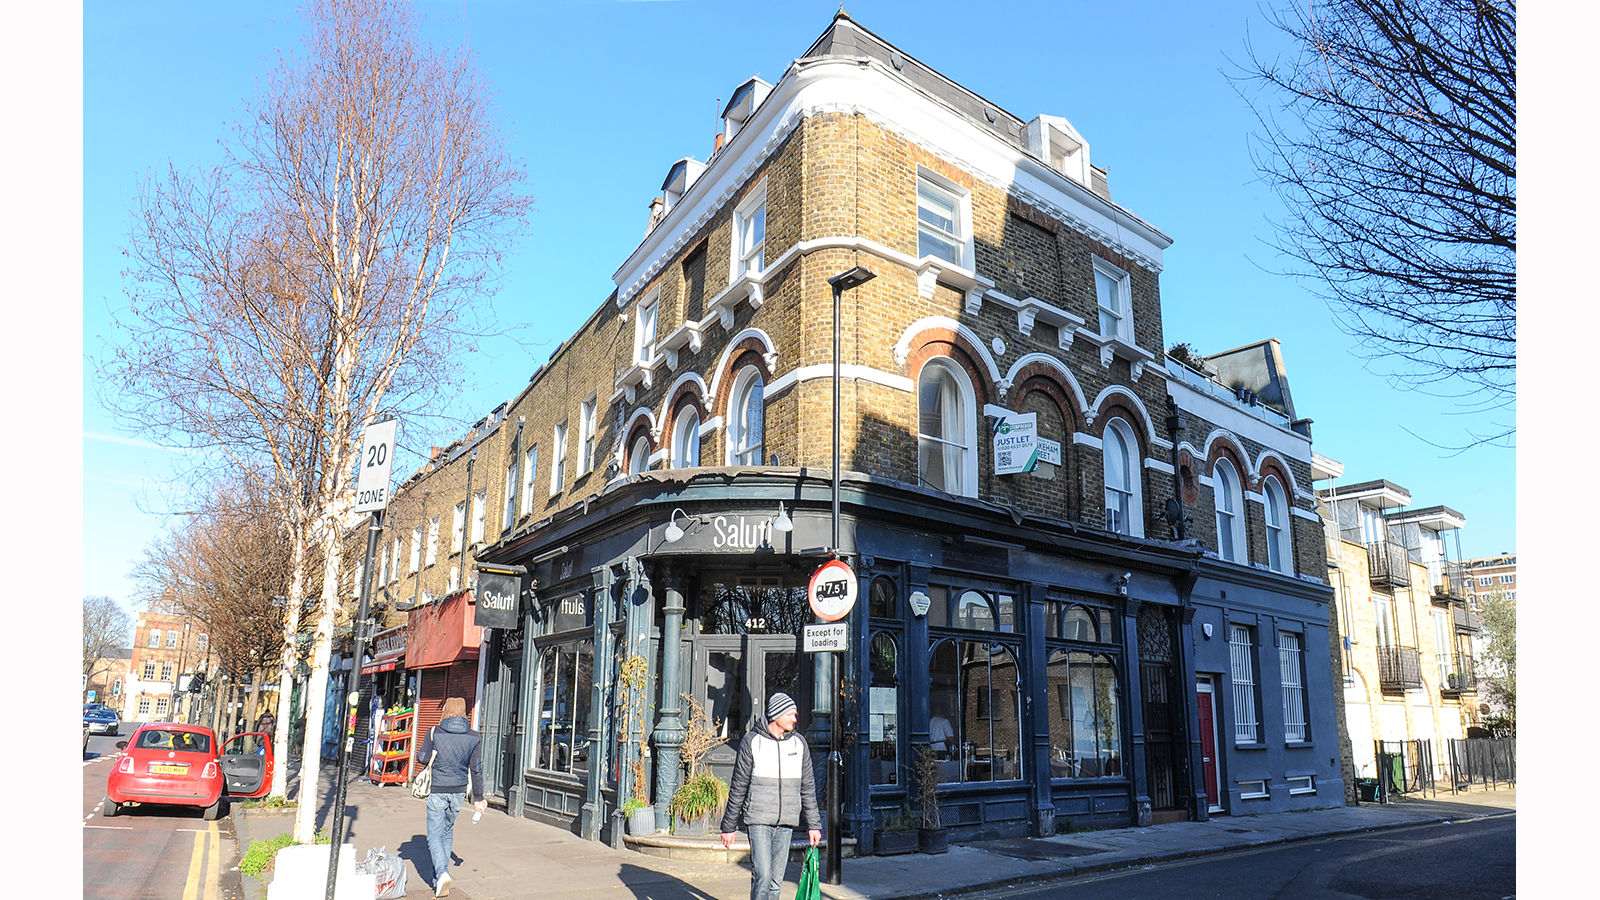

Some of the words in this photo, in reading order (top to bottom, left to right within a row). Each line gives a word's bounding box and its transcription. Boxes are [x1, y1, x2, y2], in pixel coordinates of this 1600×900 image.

[997, 437, 1015, 446] JUST
[1016, 436, 1030, 444] LET
[367, 442, 387, 468] 20
[358, 488, 384, 505] ZONE
[713, 516, 772, 548] Salut!
[482, 590, 514, 610] Salut!
[744, 618, 766, 628] 412
[806, 628, 831, 638] Except
[833, 628, 844, 636] for
[812, 639, 838, 647] loading
